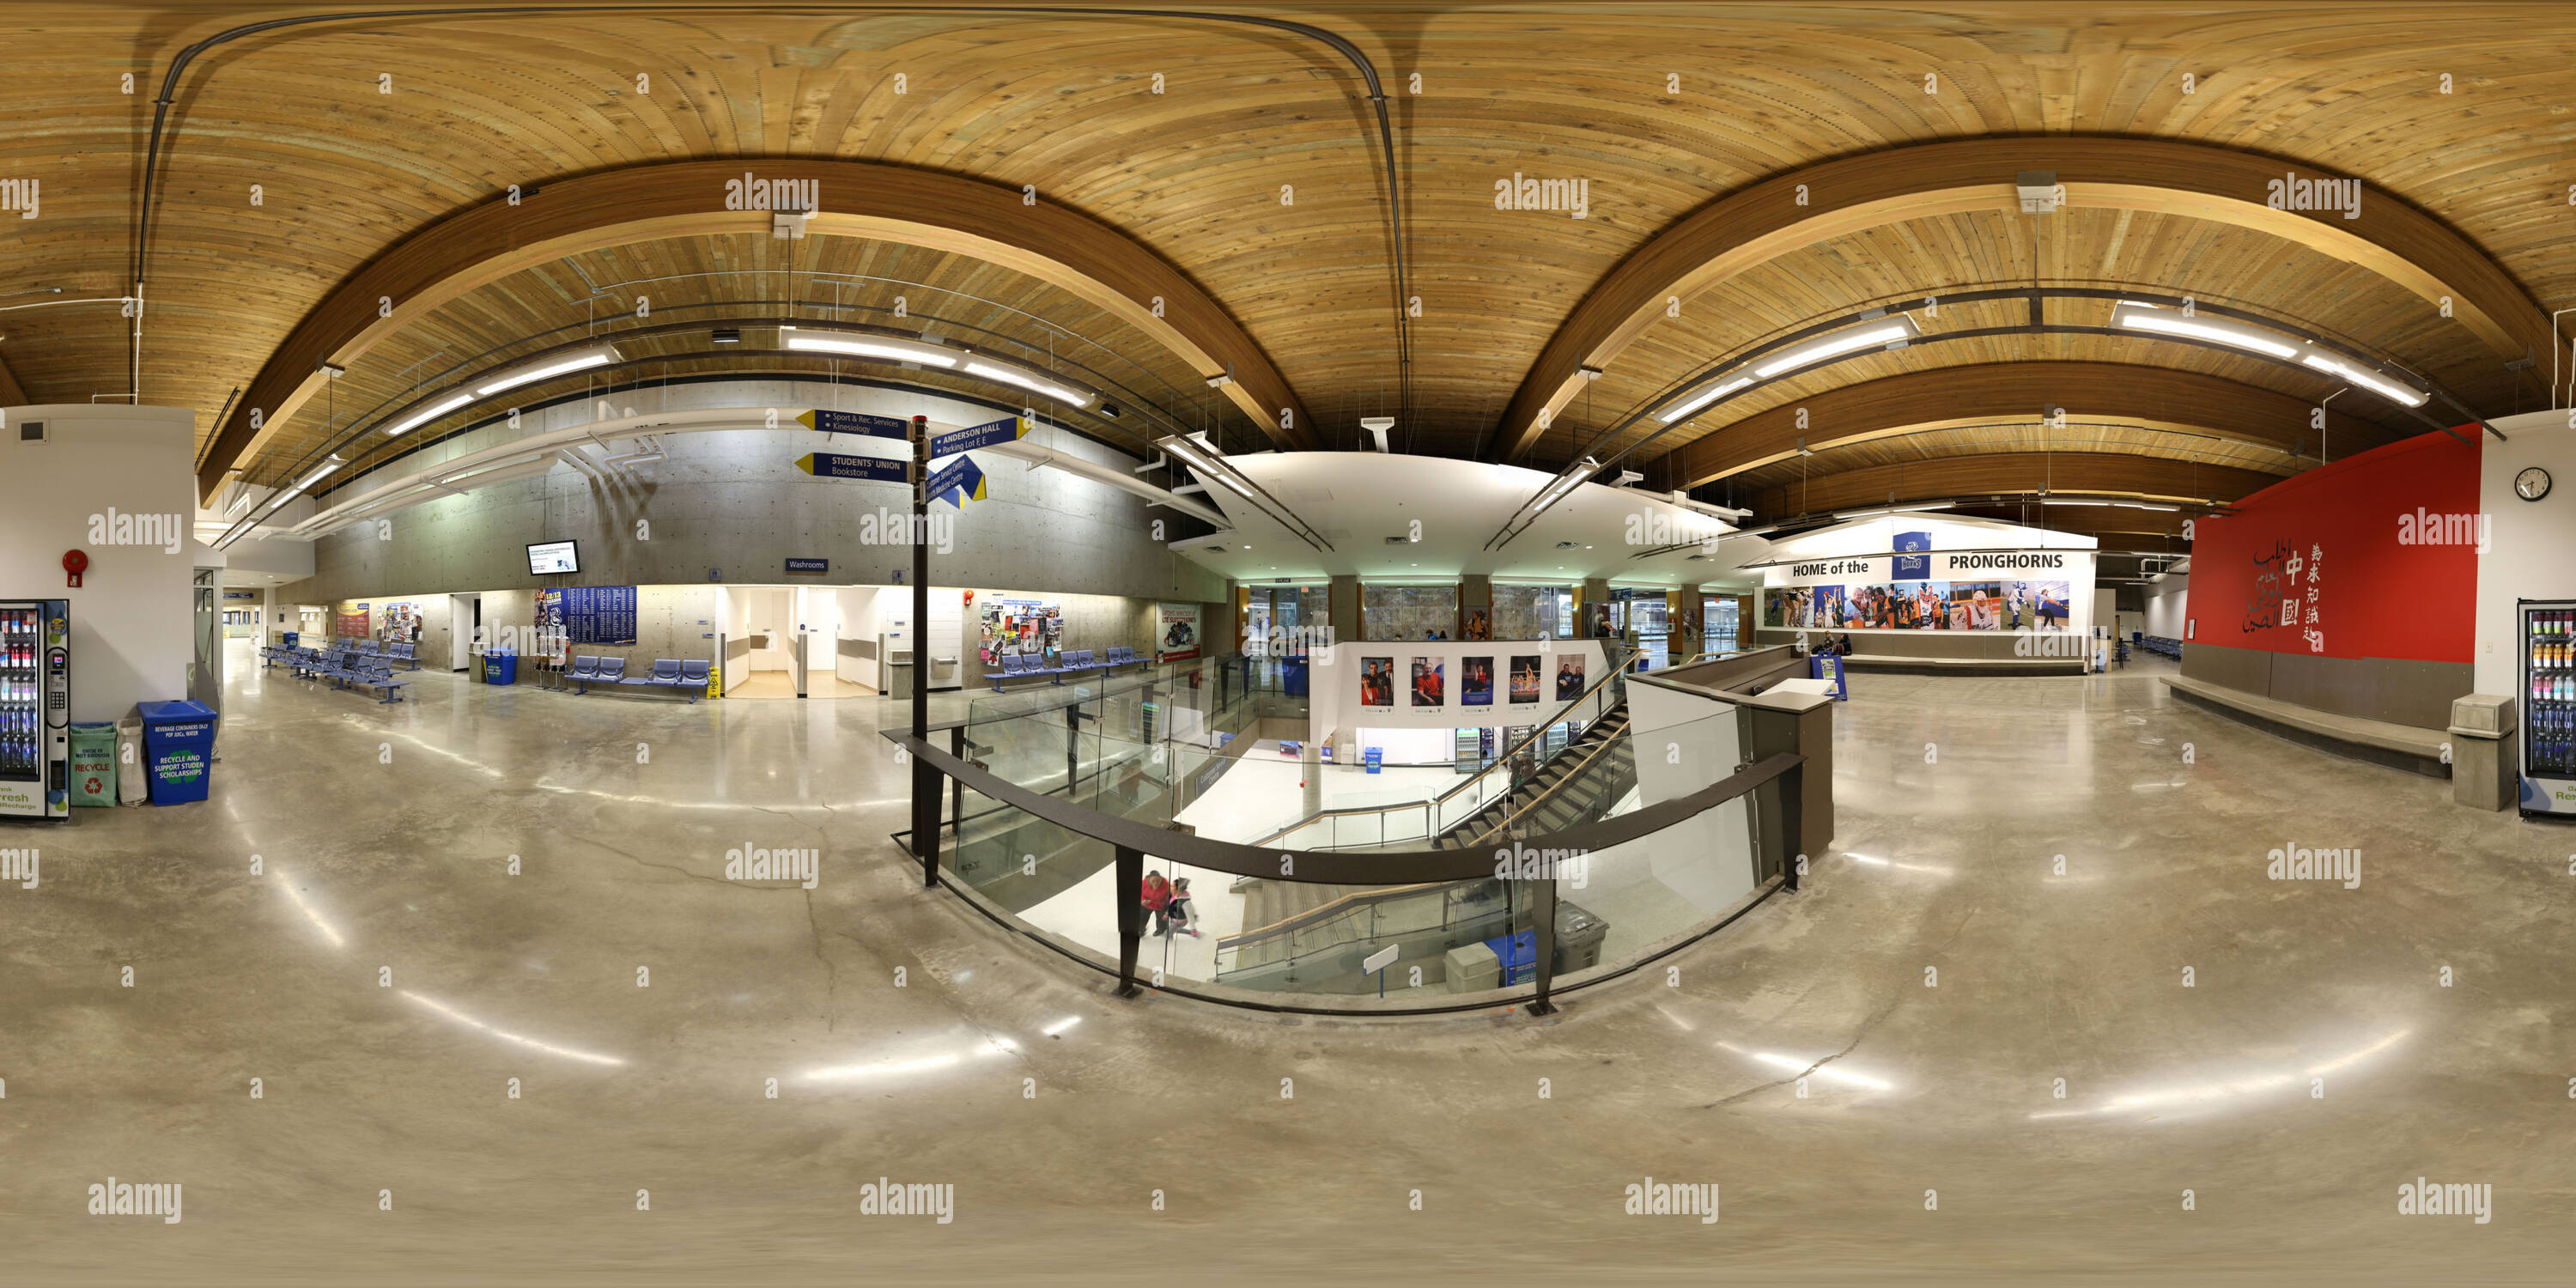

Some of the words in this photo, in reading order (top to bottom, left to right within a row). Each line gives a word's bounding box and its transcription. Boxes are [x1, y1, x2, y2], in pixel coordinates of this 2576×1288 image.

[833, 413, 850, 422] Sport
[873, 418, 899, 428] Services
[833, 422, 871, 434] Kinesiology
[943, 428, 981, 444] ANDERSON
[981, 422, 1000, 434] HALL
[942, 442, 963, 454] Parking
[965, 440, 975, 448] Lot
[832, 457, 873, 467] STUDENTS'
[876, 460, 901, 470] UNION
[952, 459, 965, 471] Centre
[832, 466, 868, 477] Bookstore
[951, 473, 963, 485] Centre
[789, 560, 824, 568] Washrooms
[1949, 555, 2063, 568] PRONGHORNS
[1793, 563, 1827, 577] HOME
[1831, 561, 1844, 574] of
[1847, 560, 1868, 573] the
[2281, 550, 2303, 627] 中國
[160, 756, 186, 764] RECYCLE
[76, 763, 110, 772] RECYCLE
[155, 763, 180, 772] SUPPORT
[159, 769, 203, 779] SCHOLARSHIPS
